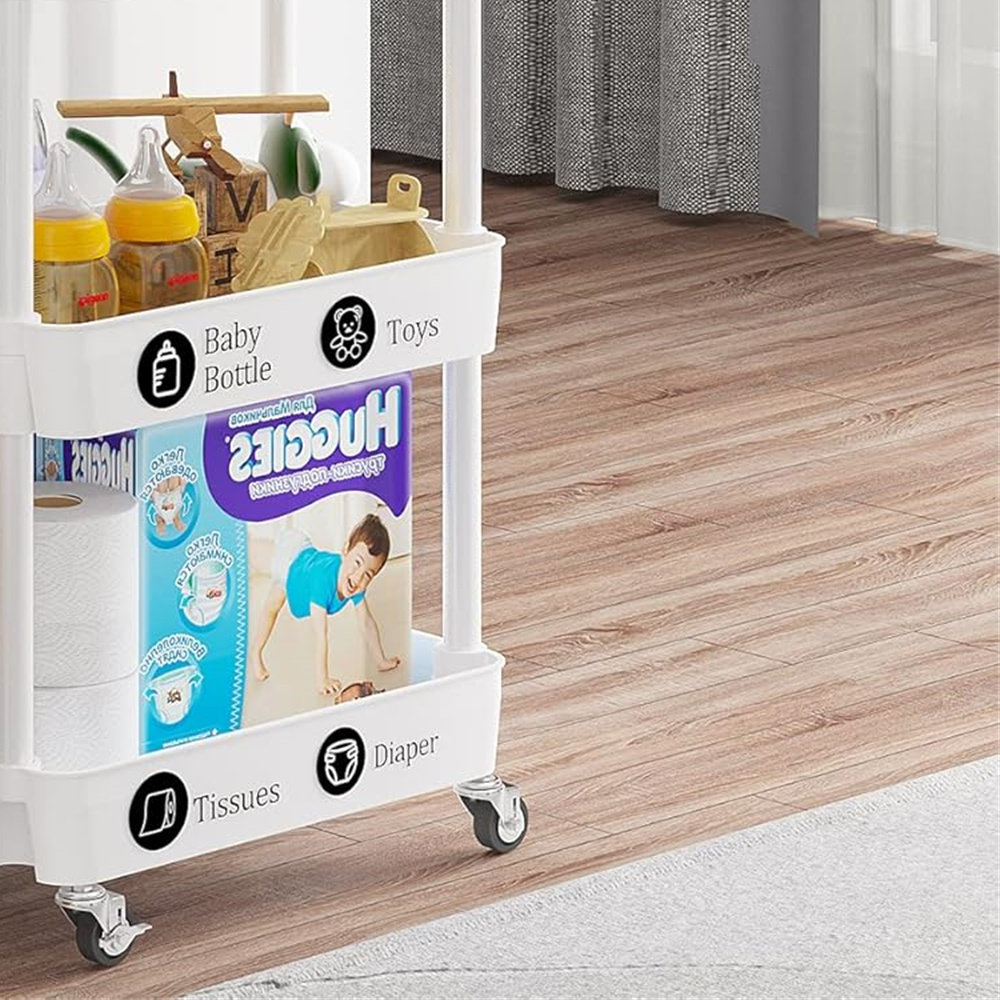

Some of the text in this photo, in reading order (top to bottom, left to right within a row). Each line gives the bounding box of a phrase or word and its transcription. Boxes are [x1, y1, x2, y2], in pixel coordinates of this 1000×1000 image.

[225, 180, 259, 222] V
[204, 321, 262, 355] Baby
[387, 317, 440, 347] Toys
[204, 355, 273, 394] Bottle
[374, 735, 440, 769] Diaper
[192, 782, 281, 824] Tissues
